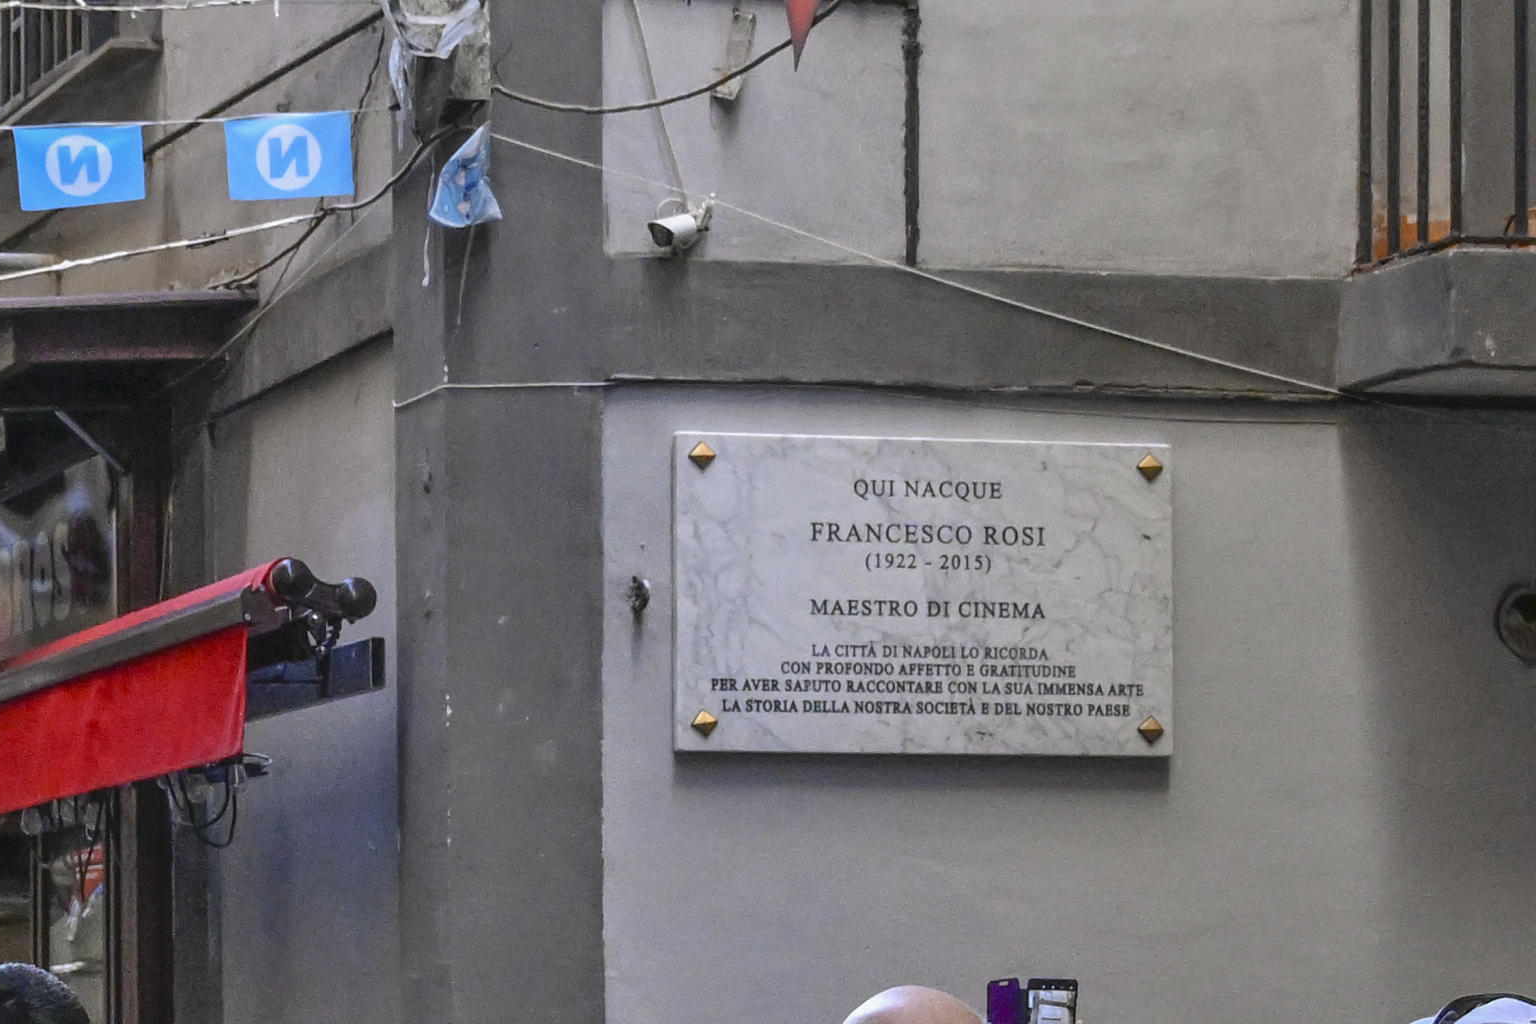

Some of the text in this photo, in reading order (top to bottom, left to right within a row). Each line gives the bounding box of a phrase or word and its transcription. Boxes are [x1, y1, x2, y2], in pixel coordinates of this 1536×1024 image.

[854, 479, 1002, 502] QUI NACQUE
[810, 522, 1046, 546] FRANCESCO ROSI
[865, 553, 917, 571] (1922
[940, 554, 991, 573] 2015)
[810, 599, 1046, 619] MAESTRO DI CINEMA
[811, 641, 1048, 660] LA CITTÀ DI NAPOLI LO RICORDA
[781, 662, 1076, 678] CON PROFONDO AFFETTO E GRATITUDINE
[711, 678, 1144, 696] PER AVER SAPUTO RACCONTARE CON LA SUA IMMENSA ARTE
[722, 698, 1131, 717] LA STORIA DELLA NOSTRA SOCIETÀ E DEL NOSTRO PAESE
